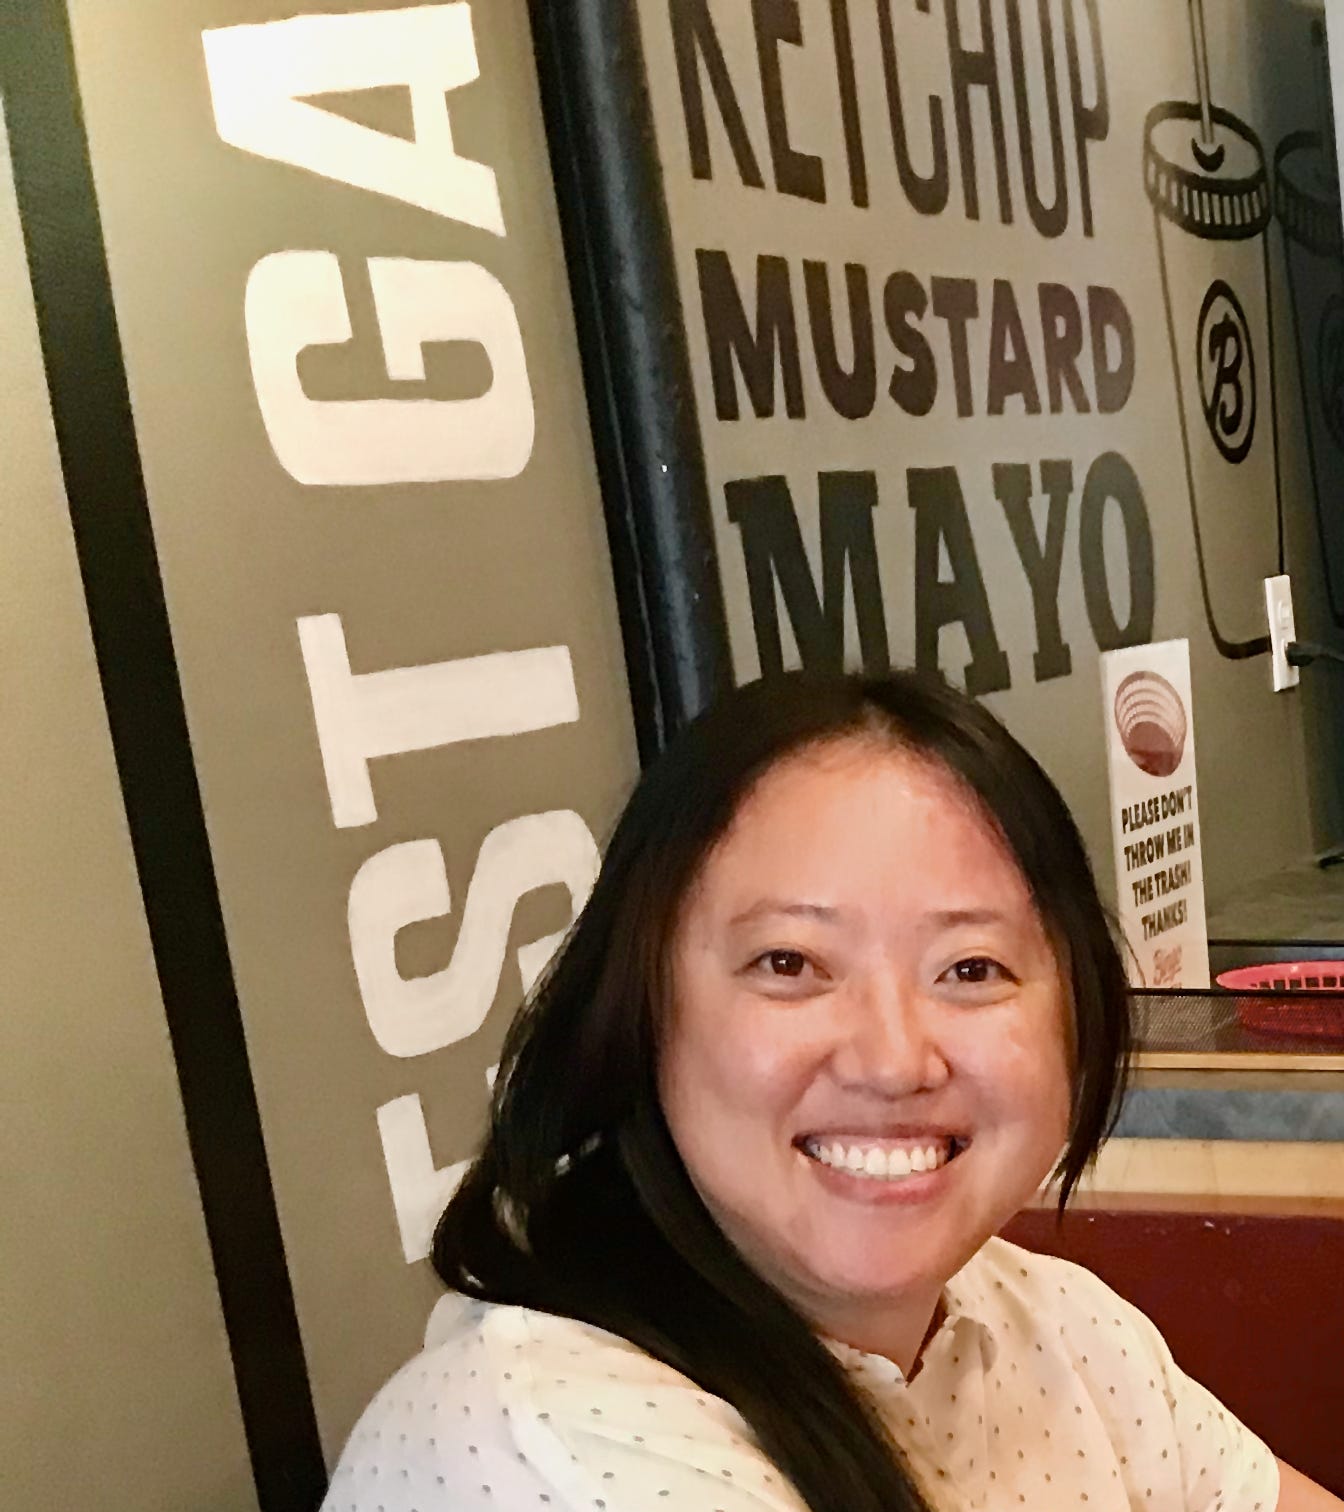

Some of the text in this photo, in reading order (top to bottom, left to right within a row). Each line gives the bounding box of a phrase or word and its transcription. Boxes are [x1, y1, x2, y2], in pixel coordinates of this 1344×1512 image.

[202, 1, 535, 486] GA
[694, 248, 1136, 421] MUSTARD
[724, 450, 1156, 693] MAYO
[1121, 785, 1193, 834] PLEASE DON'T
[1124, 822, 1195, 871] THROW ME IN
[1132, 859, 1192, 907] THE TRASH!
[1141, 899, 1188, 941] THANKS!
